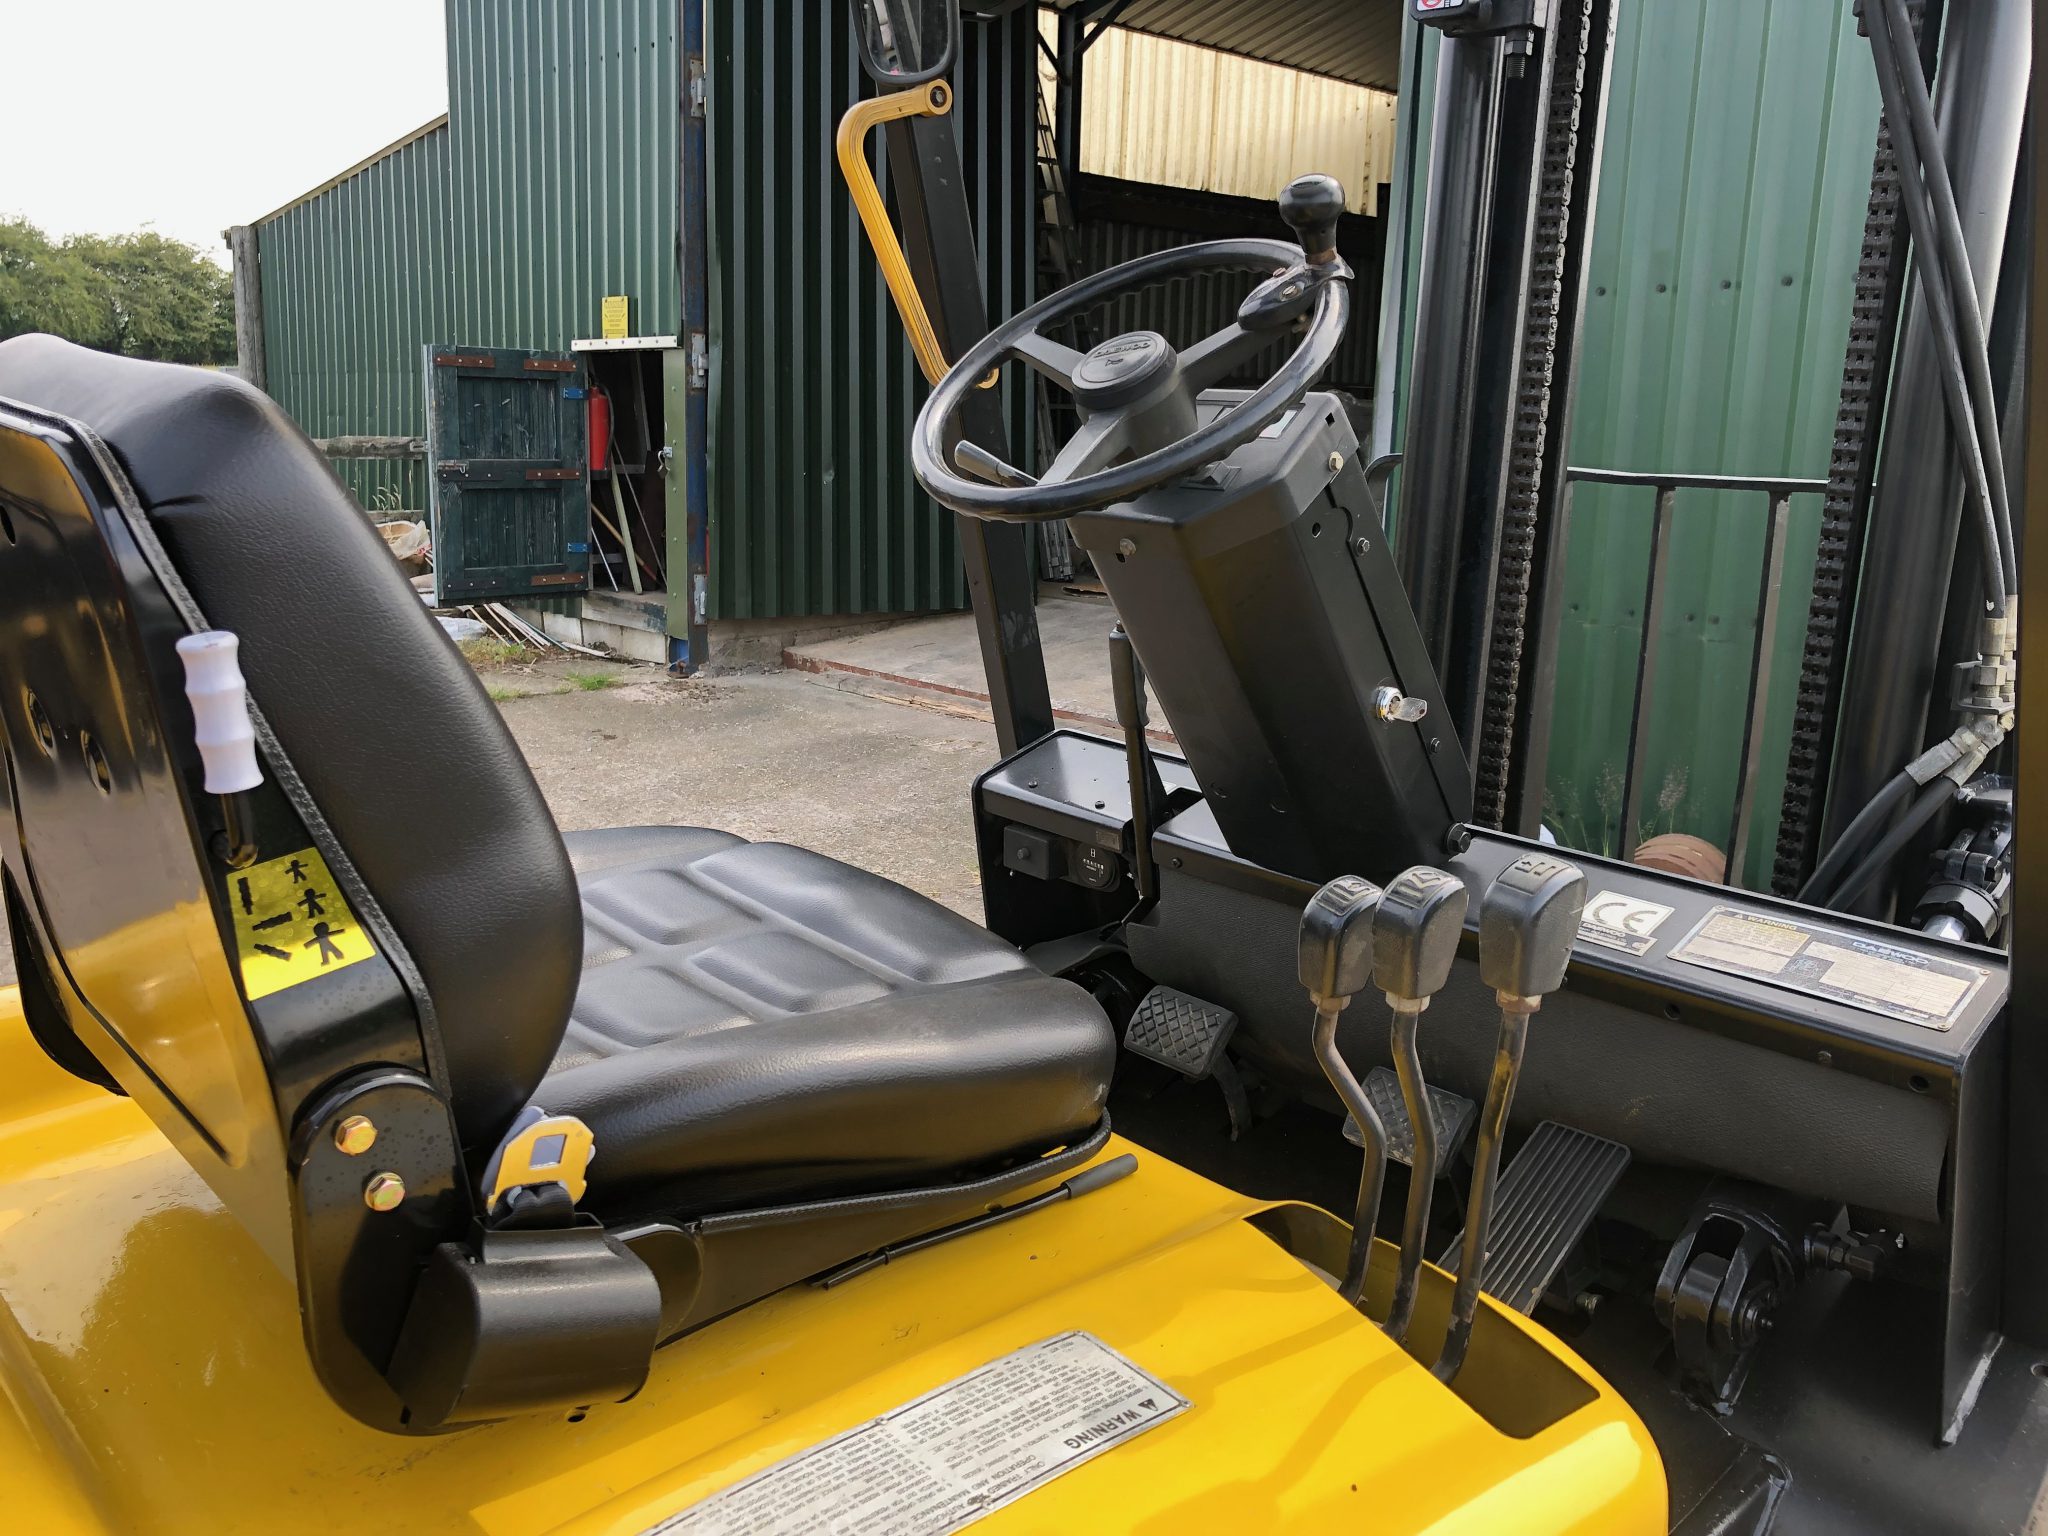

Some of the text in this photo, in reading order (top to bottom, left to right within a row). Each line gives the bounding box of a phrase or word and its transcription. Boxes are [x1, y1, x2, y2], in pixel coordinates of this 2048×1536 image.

[1592, 902, 1658, 934] CE
[1747, 915, 1798, 931] WARNING
[1852, 941, 1929, 964] DAEWOO
[1061, 1407, 1143, 1450] WARNING
[989, 1453, 1038, 1480] OPERATION
[984, 1472, 1023, 1494] TRAINED
